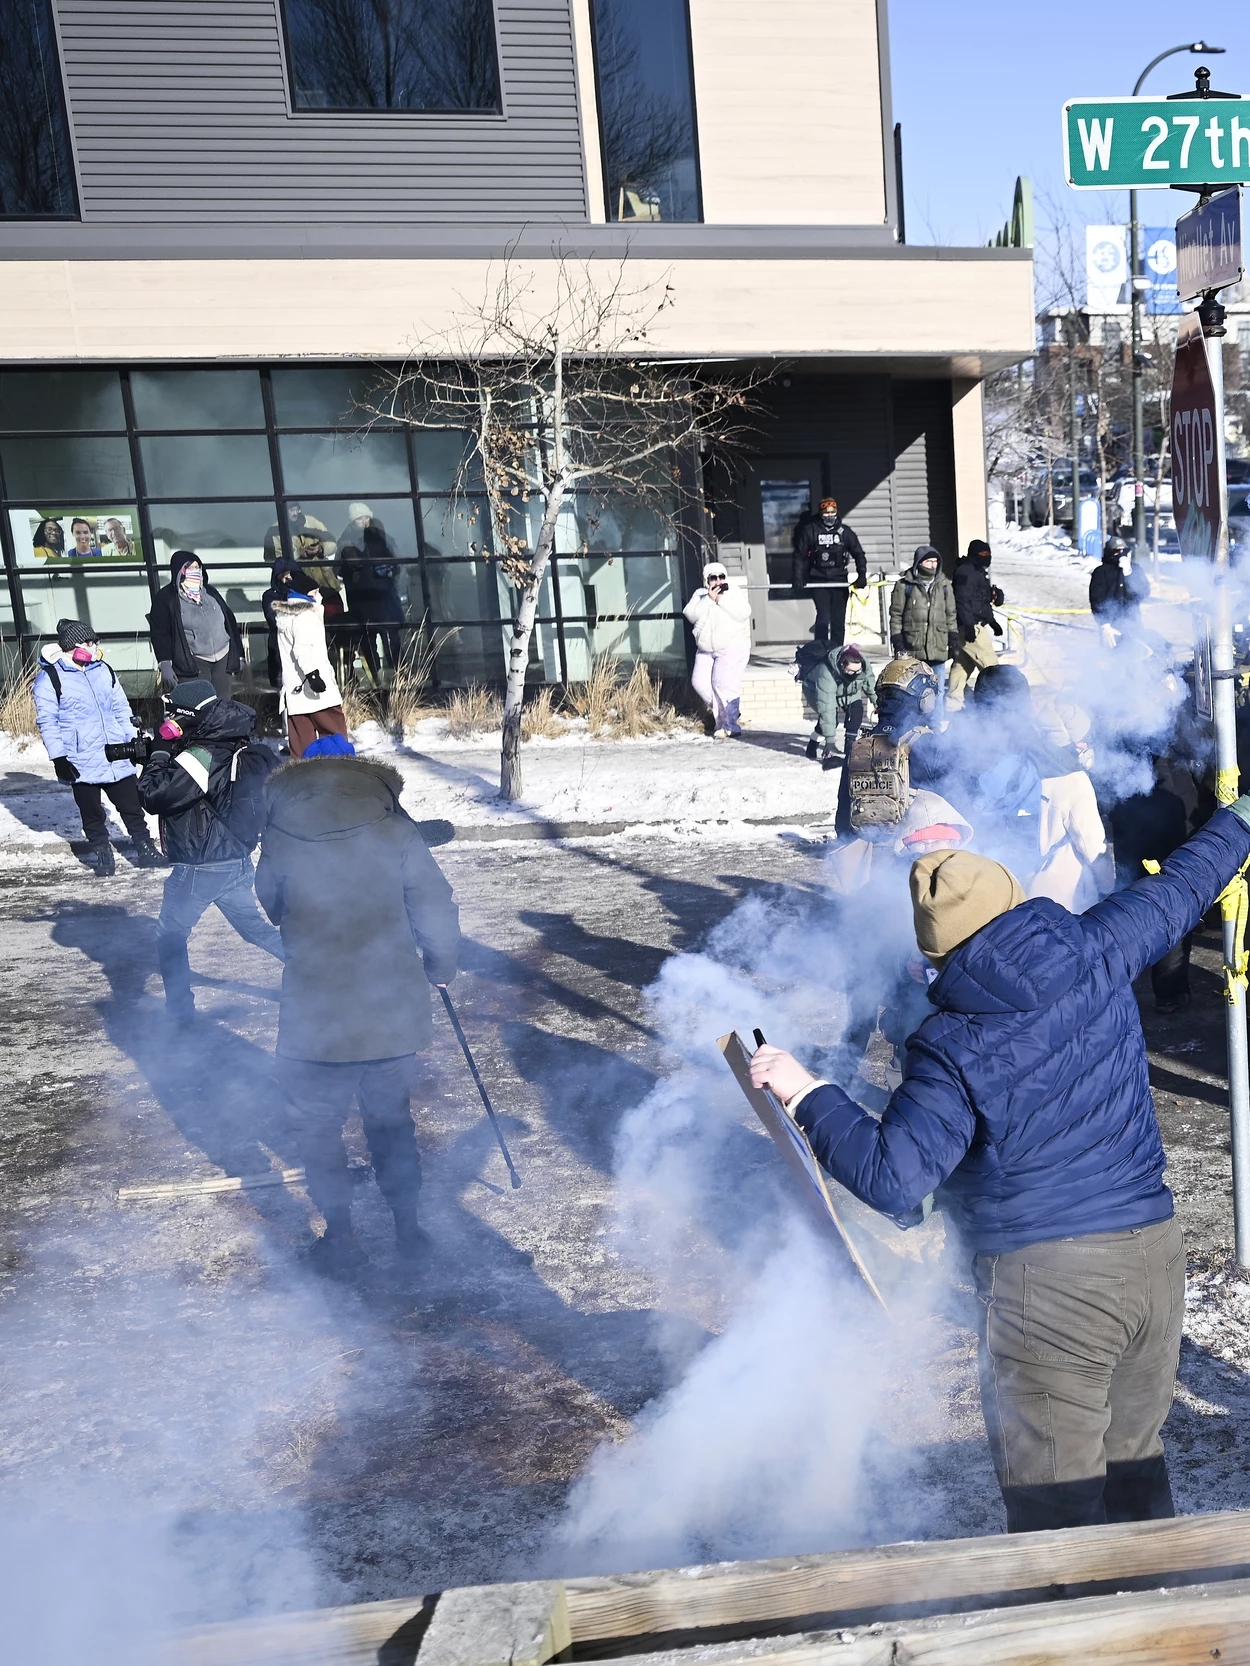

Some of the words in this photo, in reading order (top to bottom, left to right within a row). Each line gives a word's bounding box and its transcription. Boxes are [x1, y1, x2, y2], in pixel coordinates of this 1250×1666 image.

[1077, 117, 1114, 171] W
[1220, 211, 1235, 267] Av
[1174, 408, 1213, 508] STOP
[854, 780, 893, 790] POLICE
